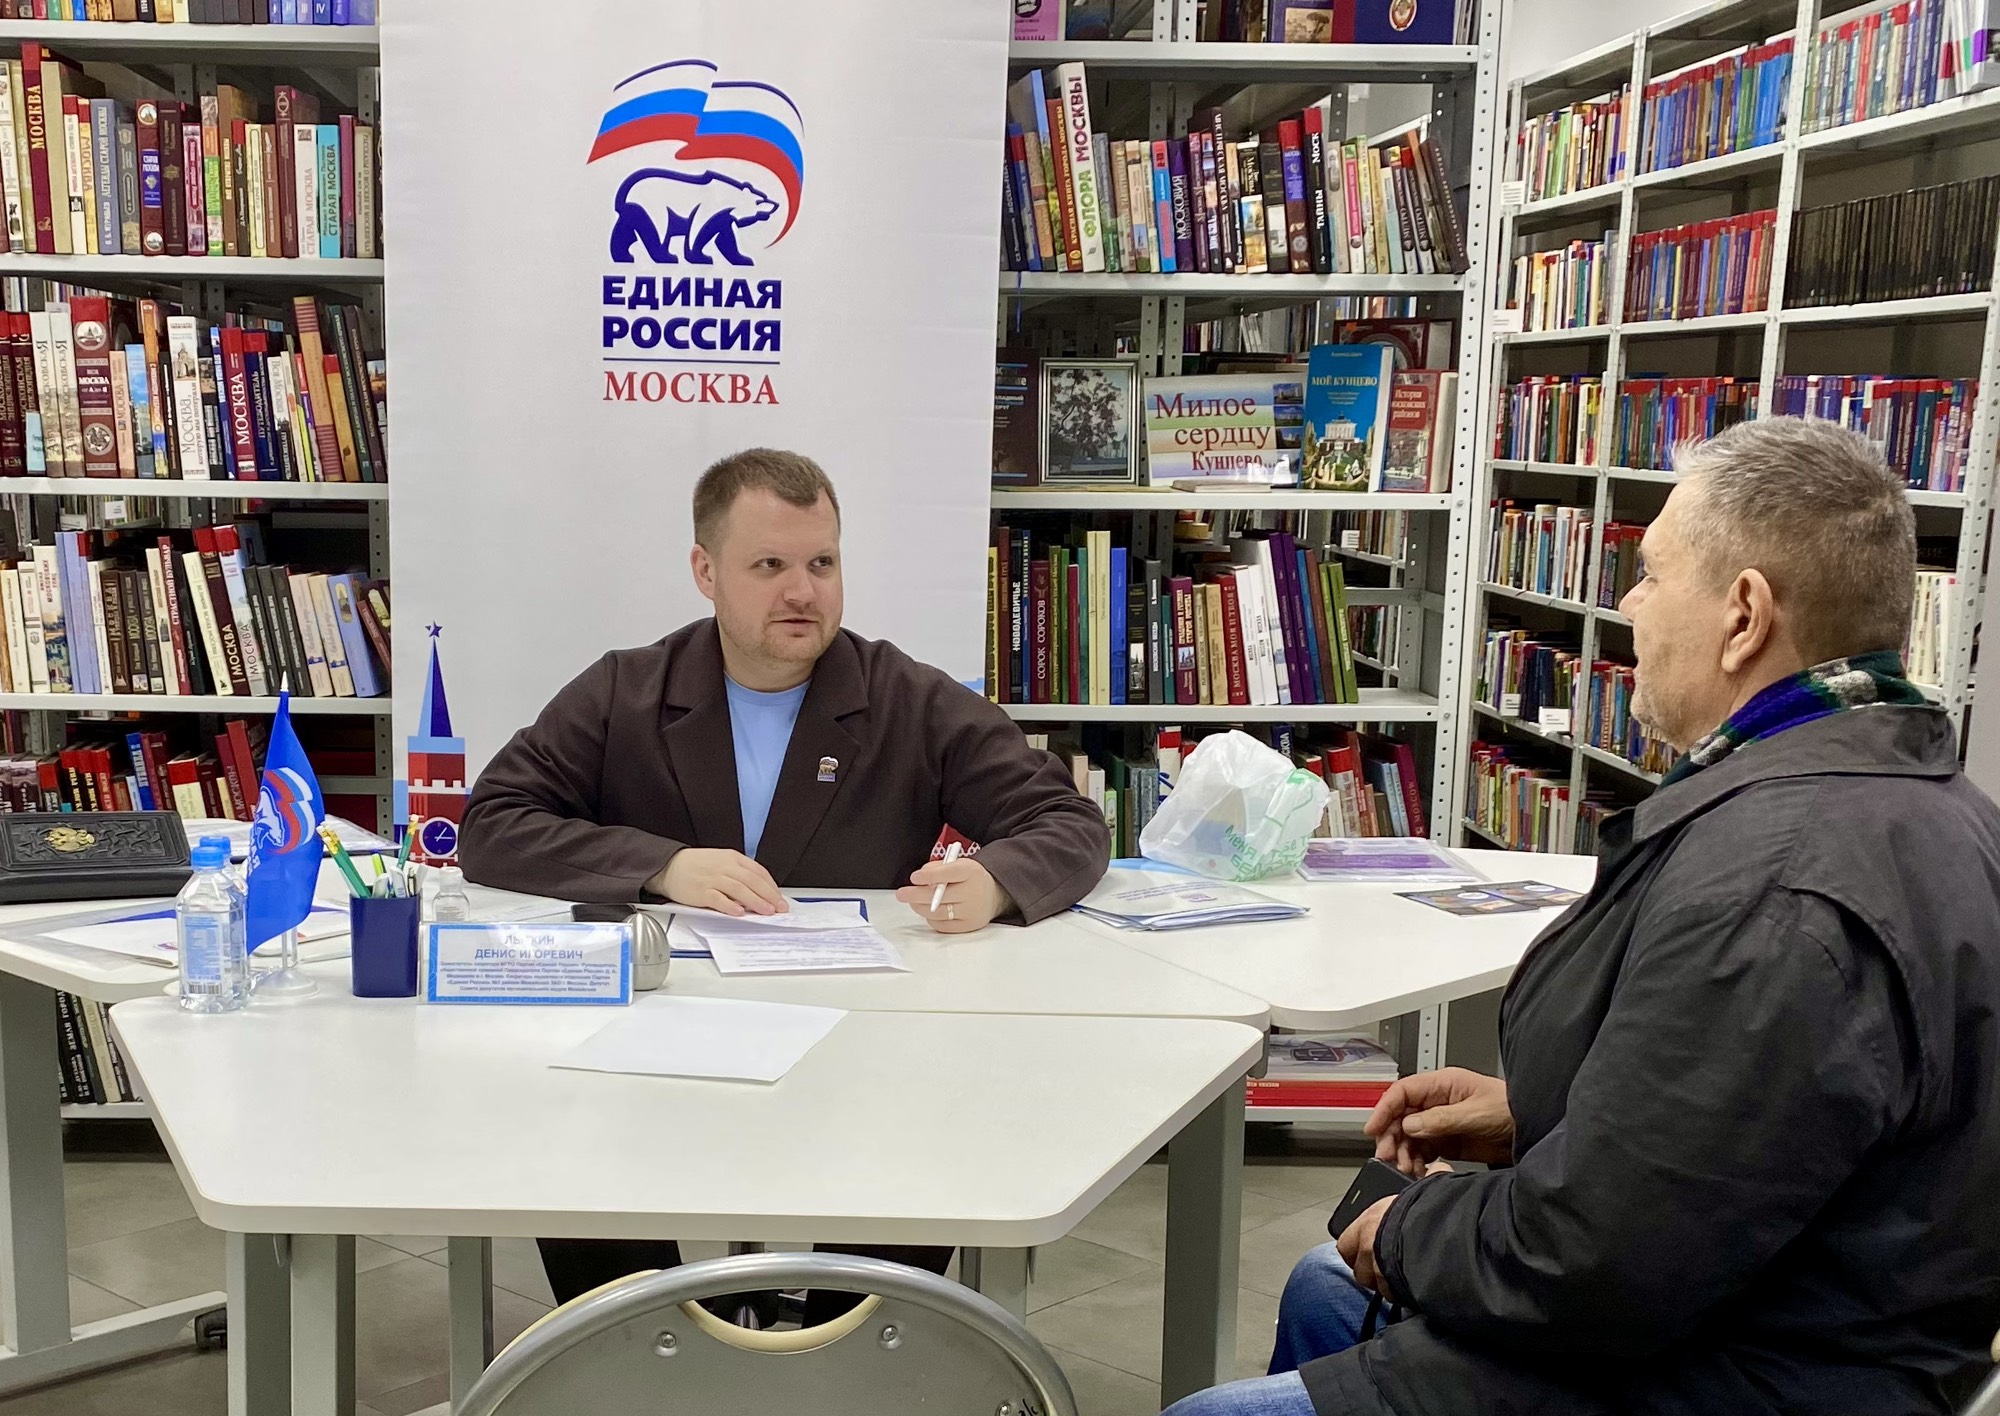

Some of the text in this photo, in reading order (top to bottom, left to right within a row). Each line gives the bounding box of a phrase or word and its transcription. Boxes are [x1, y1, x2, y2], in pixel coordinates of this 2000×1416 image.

[315, 2, 325, 14] IV
[26, 84, 46, 150] МОСКВА
[97, 106, 109, 136] МОСКВЫ
[80, 135, 93, 192] МОСКВА
[98, 136, 110, 164] СТАРОЙ
[1056, 106, 1078, 245] КРАСНАЯ КНИГА ГОРОДА МОСКВЫ
[1069, 77, 1097, 238] ФЛОРА МОСКВЫ
[101, 163, 112, 198] ЛЕГЕНДЫ
[326, 144, 338, 237] СТАРАЯ МОСКВА
[1218, 174, 1231, 211] МОСКВА
[1309, 132, 1325, 229] ТАЙНЫ МОСК
[303, 167, 316, 254] СТАРАЯ МОСКВА
[1172, 175, 1187, 240] МОСКОВИЯ
[602, 275, 782, 311] ЕДИНАЯ
[602, 315, 781, 352] РОССИЯ
[56, 340, 71, 410] МОСКОВСКАЯ
[78, 375, 109, 385] МОСКВА
[115, 383, 126, 420] МОСКВА
[602, 370, 780, 405] МОСКВА
[1333, 376, 1378, 387] КУНЦЕВО
[178, 393, 196, 455] Москва,
[190, 382, 204, 465] которую мы потеряли
[230, 372, 251, 446] МОСКВА
[251, 370, 266, 439] ПУТЕВОДИТЕЛЬ
[1154, 391, 1257, 420] Милое
[1174, 424, 1273, 451] сердцу
[43, 559, 54, 603] МОСКОВСКИХ
[161, 543, 180, 626] СТРАСТНОЙ БУЛЬВАР
[1012, 581, 1022, 652] НОВОДЕВИЧЬЕ
[1037, 599, 1047, 680] СОРОК СОРОКОВ
[1226, 592, 1242, 689] МОСКВА МОЯ И ТВОЯ
[221, 623, 243, 676] МОСКВА
[240, 623, 260, 676] МОСКВА
[1407, 781, 1421, 823] MOSCOW
[474, 949, 516, 960] ДЕНИС
